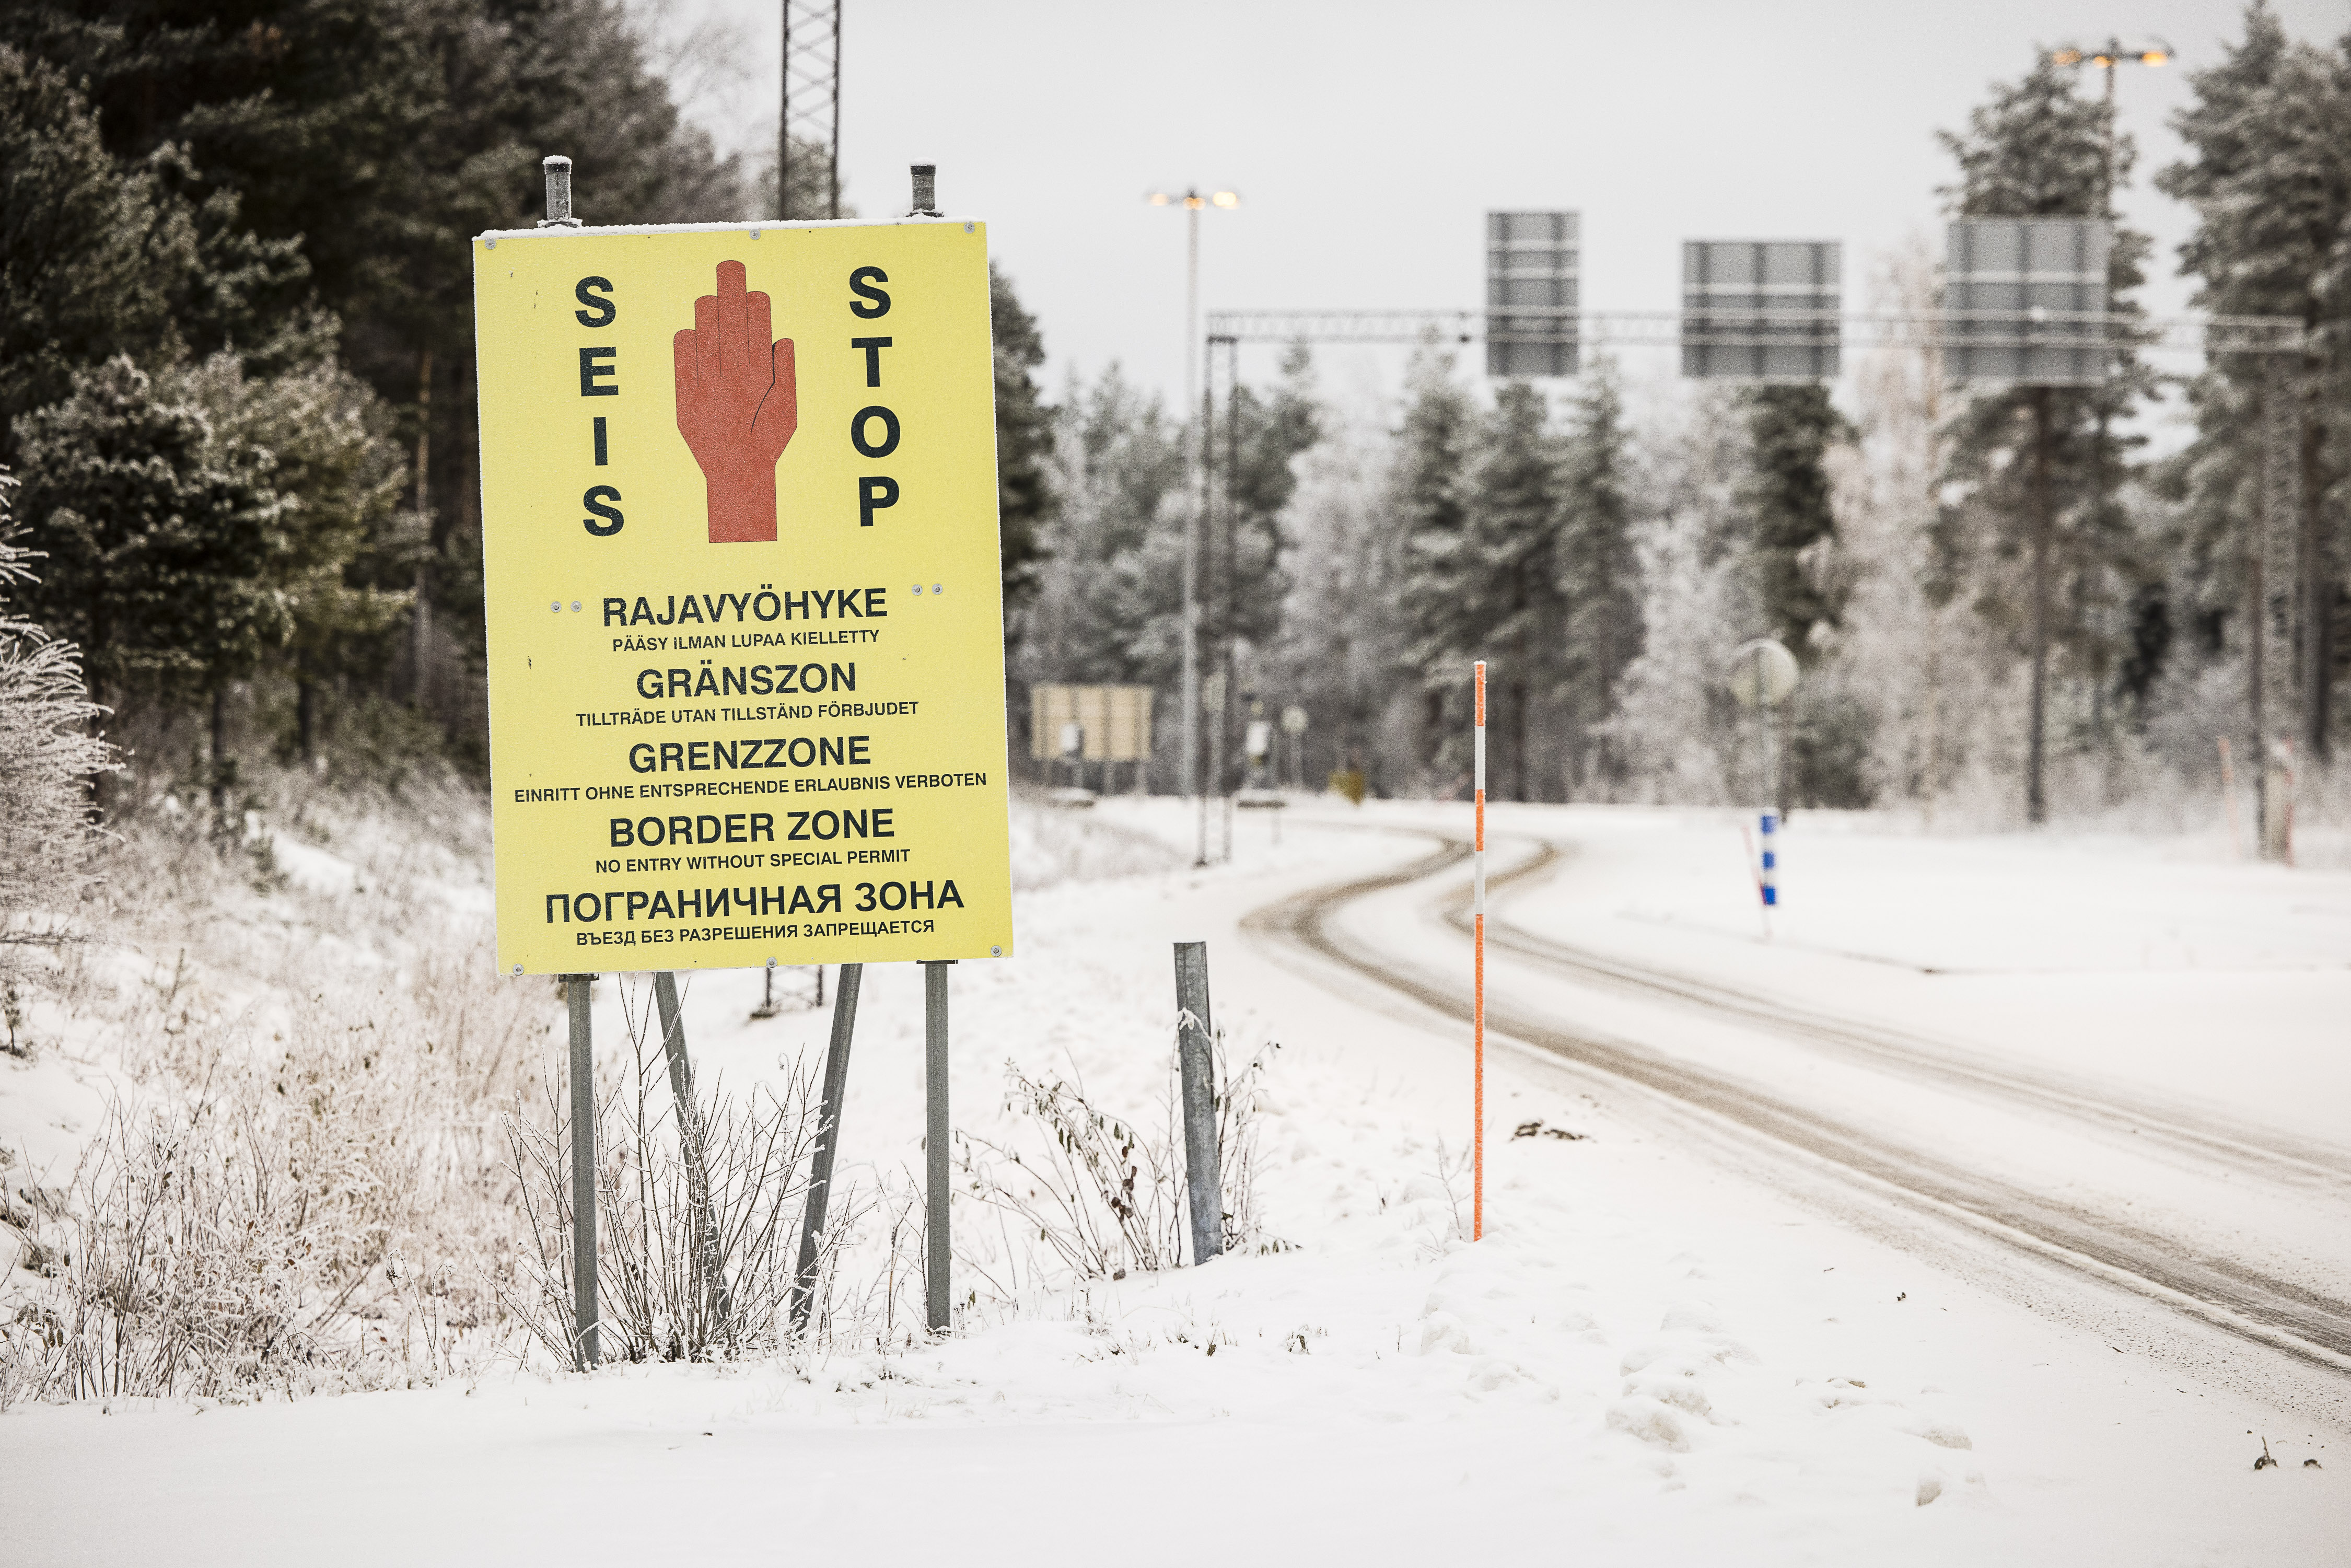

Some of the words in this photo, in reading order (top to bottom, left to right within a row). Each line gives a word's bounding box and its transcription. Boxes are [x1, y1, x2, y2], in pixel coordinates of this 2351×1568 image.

[575, 276, 624, 537] SEIS
[849, 266, 901, 527] STOP
[603, 584, 888, 627] RAJAVYÖHYKE
[613, 634, 668, 652] PÄÄSY
[673, 635, 726, 649] ILMAN
[731, 633, 786, 647] LUPAA
[791, 629, 879, 645] KIELLETTY
[636, 659, 856, 699] GRÄNSZON
[576, 708, 666, 726] TILLTRÄDE
[671, 709, 716, 723] UTAN
[720, 703, 812, 721] TILLSTÄND
[818, 701, 919, 718] FÖRBJUDET
[629, 735, 871, 773] GRENZZONE
[515, 787, 580, 803] EINRITT
[586, 785, 634, 800] OHNE
[639, 780, 789, 798] ENTSPRECHENDE
[795, 776, 890, 792] ERLAUBNIS
[895, 772, 986, 788] VERBOTEN
[610, 812, 775, 847] BORDER
[787, 808, 895, 841] ZONE
[596, 859, 621, 873] NO
[626, 857, 682, 872] ENTRY
[686, 854, 765, 870] WITHOUT
[770, 852, 842, 867] SPECIAL
[847, 849, 911, 864] PERMIT
[546, 884, 841, 923] ПОГРАНИЧНАЯ
[855, 879, 965, 912] ЗОНА
[577, 931, 636, 947] ВЪЕЗД
[641, 929, 674, 943] БЕЗ
[680, 925, 798, 942] РАЗРЕШЕНИЯ
[803, 920, 934, 937] ЗАПРЕЩАЕТСЯ
